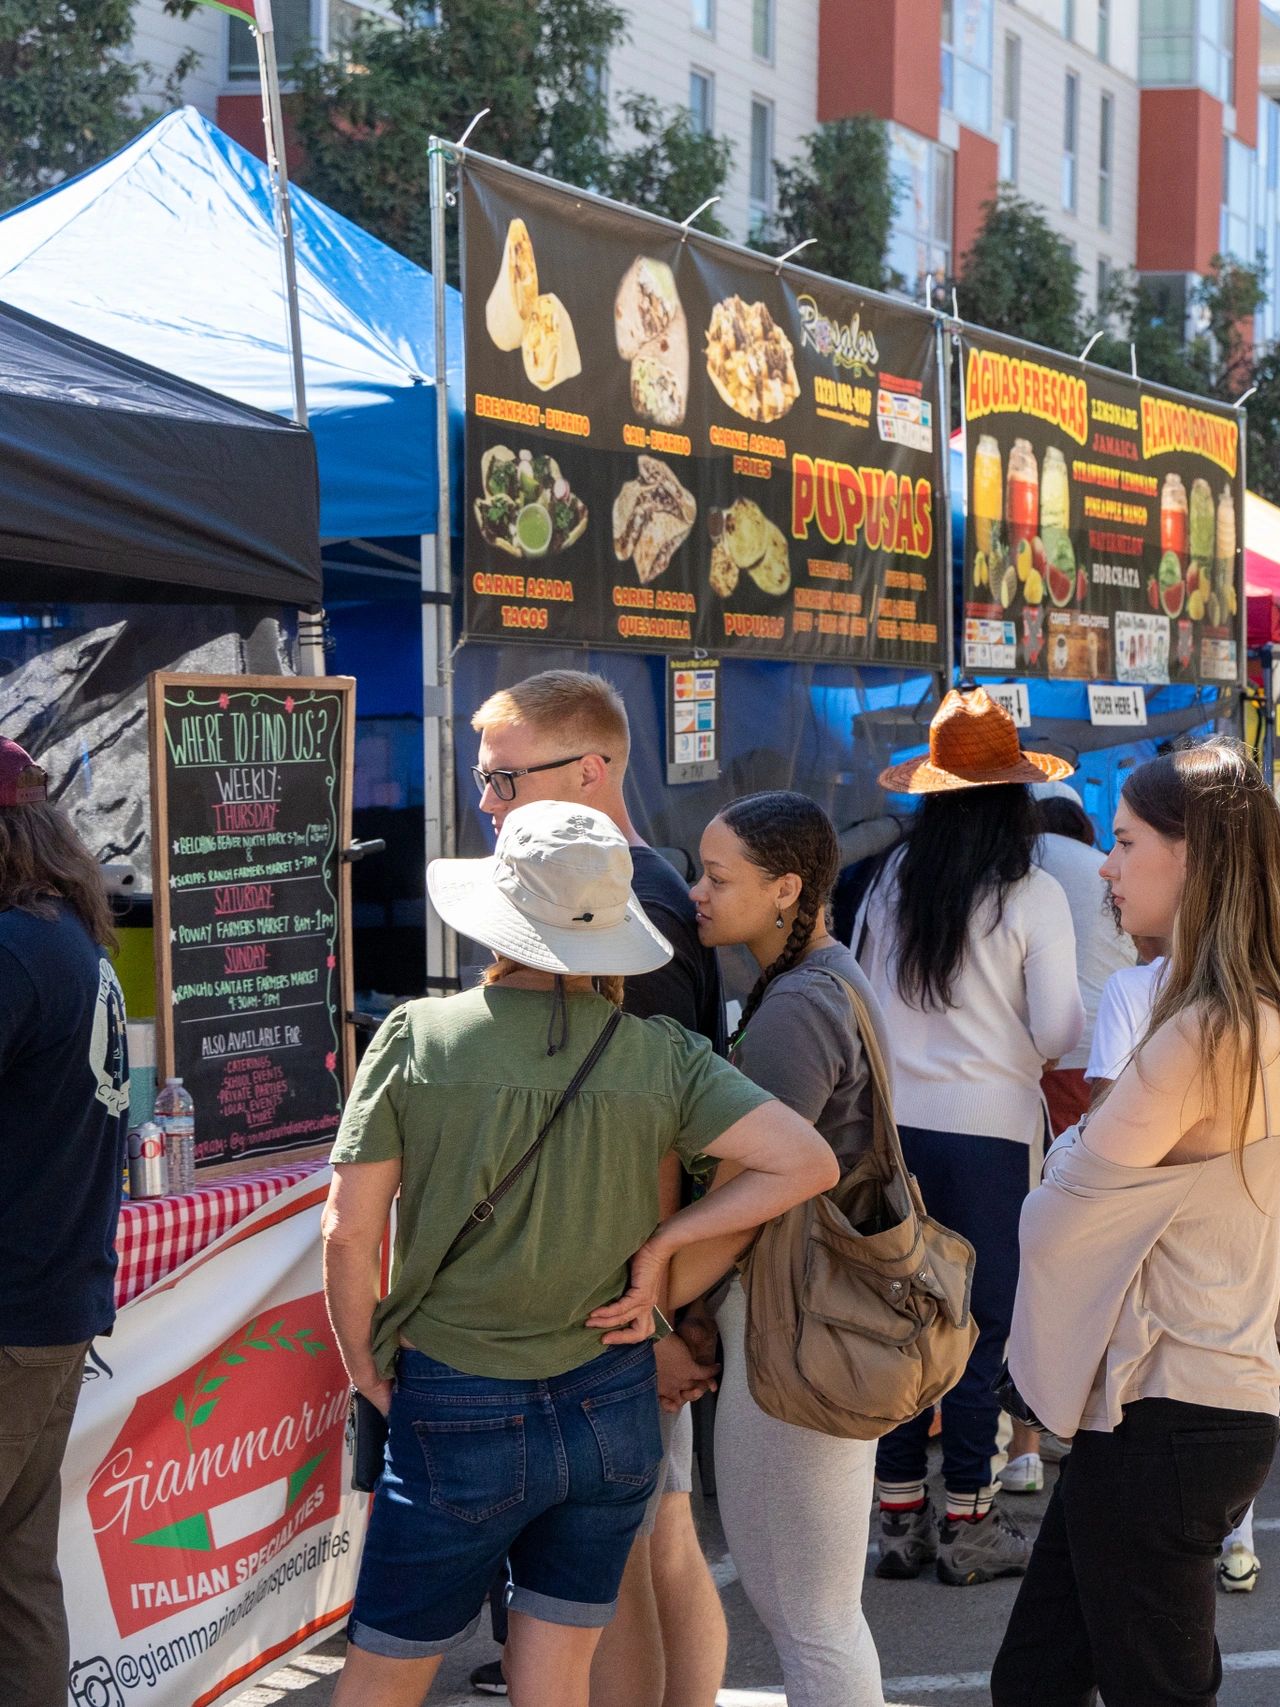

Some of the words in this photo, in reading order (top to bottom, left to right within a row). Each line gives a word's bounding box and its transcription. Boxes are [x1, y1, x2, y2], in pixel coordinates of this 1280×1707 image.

[966, 347, 1020, 421] AGUAS
[1020, 360, 1088, 446] FRESCAS
[475, 394, 540, 427] BREAKFAST
[545, 408, 590, 437] BURRITO
[1091, 398, 1138, 430] LEMONADE
[623, 424, 646, 447] CALI
[650, 429, 691, 456] BURRITO
[709, 425, 748, 451] CARNE
[749, 434, 786, 459] ASADA
[1092, 433, 1139, 461] JAMAICA
[1140, 395, 1189, 460] FLAVOR
[1189, 408, 1238, 479] DRINKS
[733, 455, 772, 478] FRIES
[792, 453, 932, 559] PUPUSAS
[473, 572, 525, 597] CARNE
[525, 577, 574, 601] ASADA
[1092, 563, 1140, 589] HORCHATA
[613, 586, 654, 609] CARNE
[655, 589, 696, 613] ASADA
[501, 605, 548, 630] TACOS
[618, 615, 691, 640] QUESADILLA
[724, 612, 785, 639] PUPUSAS
[1093, 695, 1114, 715] ORDER
[1115, 696, 1131, 715] HERE
[164, 713, 227, 765] WHERE
[230, 713, 249, 763] TO
[251, 712, 287, 762] FIND
[292, 709, 327, 761] US?
[215, 766, 282, 802] WEEKLY:
[243, 834, 266, 848] NORTH
[267, 833, 286, 846] PARK
[176, 872, 206, 887] SCRIPPS
[208, 868, 233, 882] RANCH
[233, 864, 265, 880] FARMERS
[266, 860, 293, 875] MARKET
[179, 923, 212, 944] POWAY
[217, 919, 255, 938] FARMERS
[257, 916, 290, 935] MARKET
[177, 981, 213, 1001] RANCHO
[215, 979, 241, 996] SANTA
[256, 975, 289, 992] FARMERS
[290, 968, 318, 986] MARKET
[202, 1034, 226, 1056] ALSO
[228, 1026, 280, 1052] AVAILABLE
[253, 1066, 284, 1085] EVENTS
[254, 1080, 288, 1099] PARTIES
[250, 1095, 283, 1113] EVENTS
[130, 1566, 231, 1610] ITALIAN
[236, 1483, 325, 1585] SPECIALTIES
